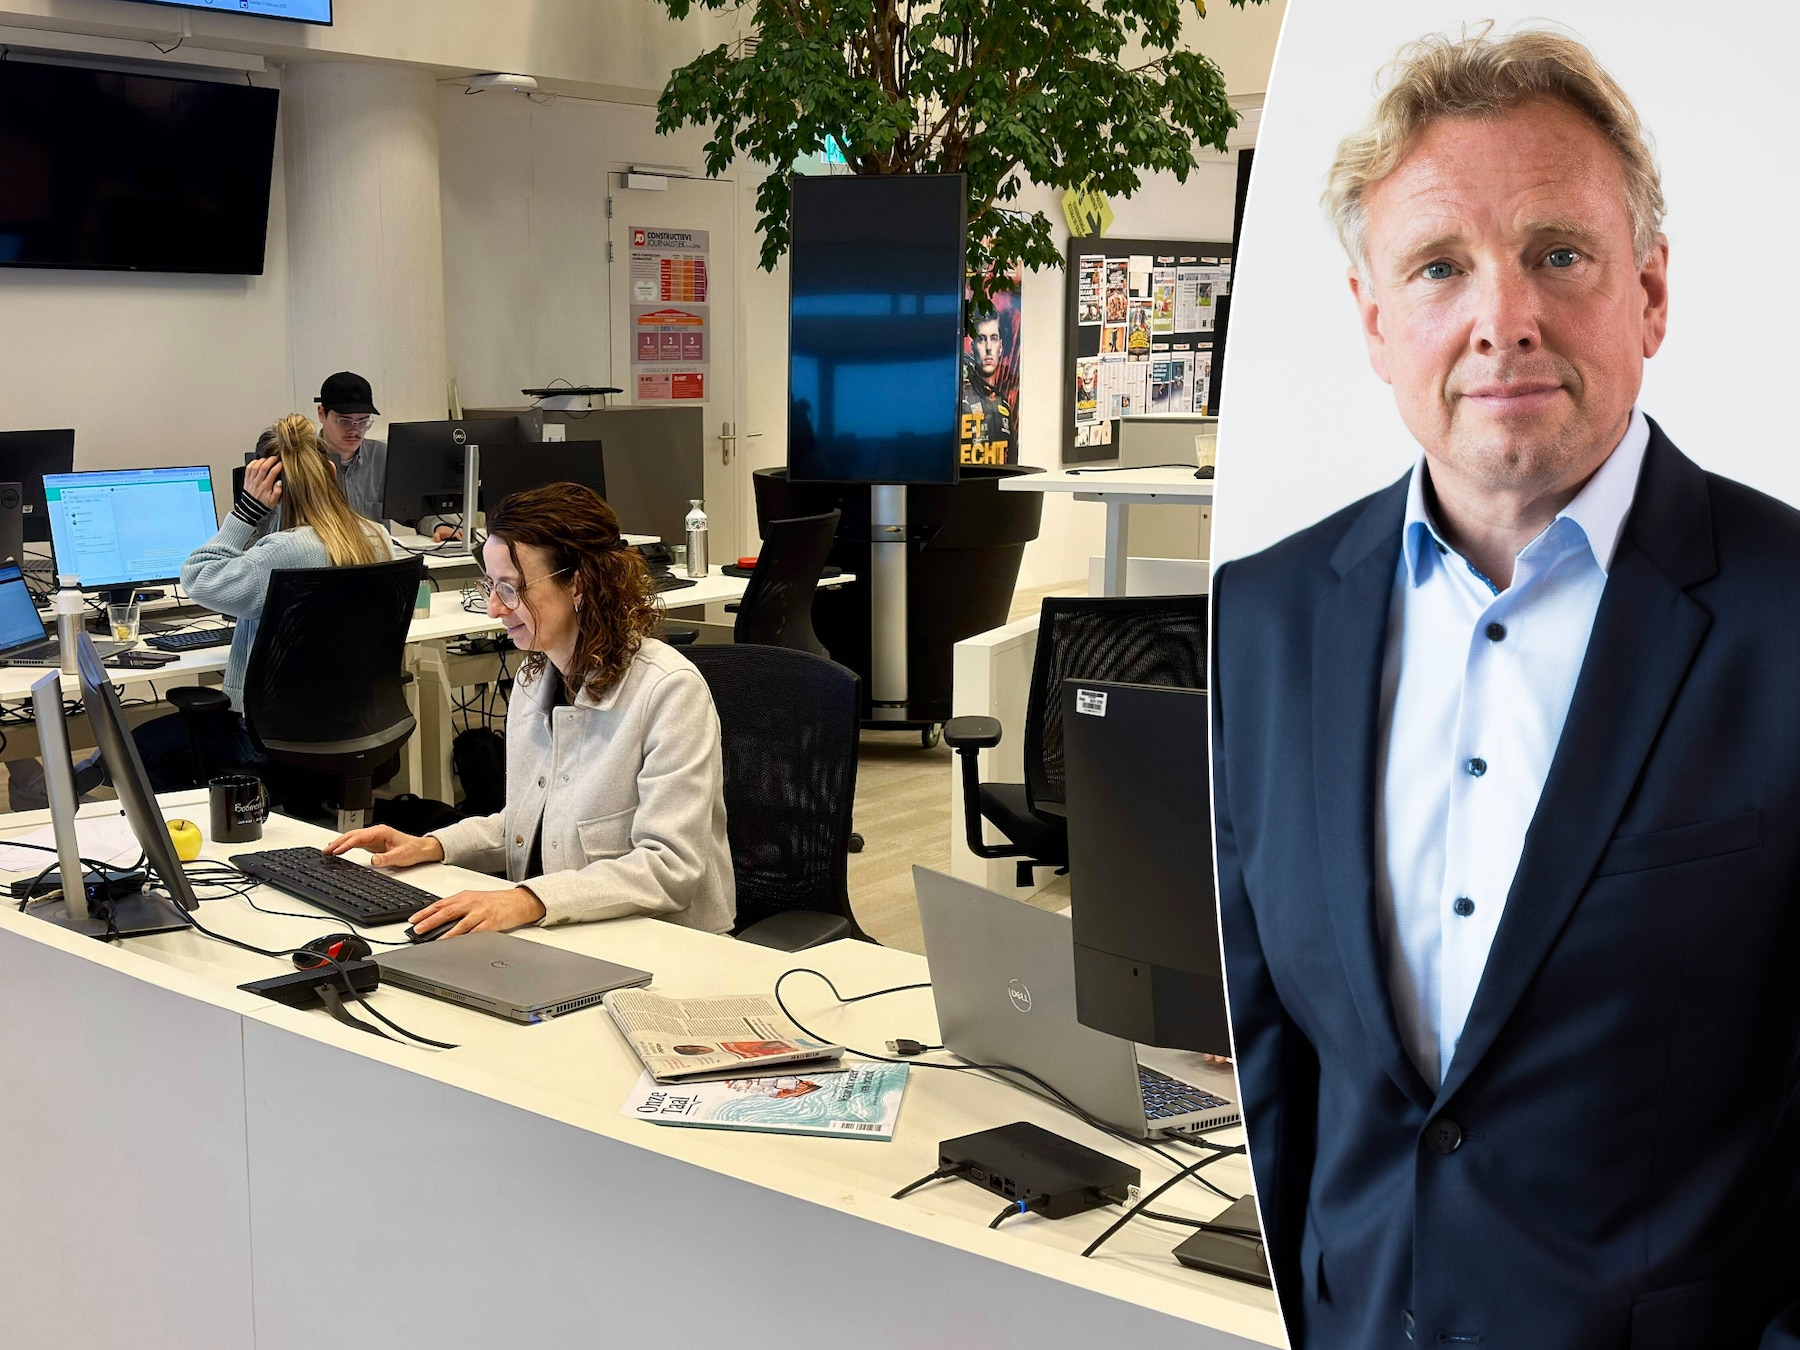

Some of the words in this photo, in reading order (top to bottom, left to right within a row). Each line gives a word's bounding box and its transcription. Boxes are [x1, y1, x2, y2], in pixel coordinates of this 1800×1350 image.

[647, 232, 692, 241] CONSTRUCTIEVE
[668, 336, 673, 345] 2
[689, 336, 695, 345] 3
[636, 1092, 668, 1113] Onze
[660, 1096, 690, 1115] Taal
